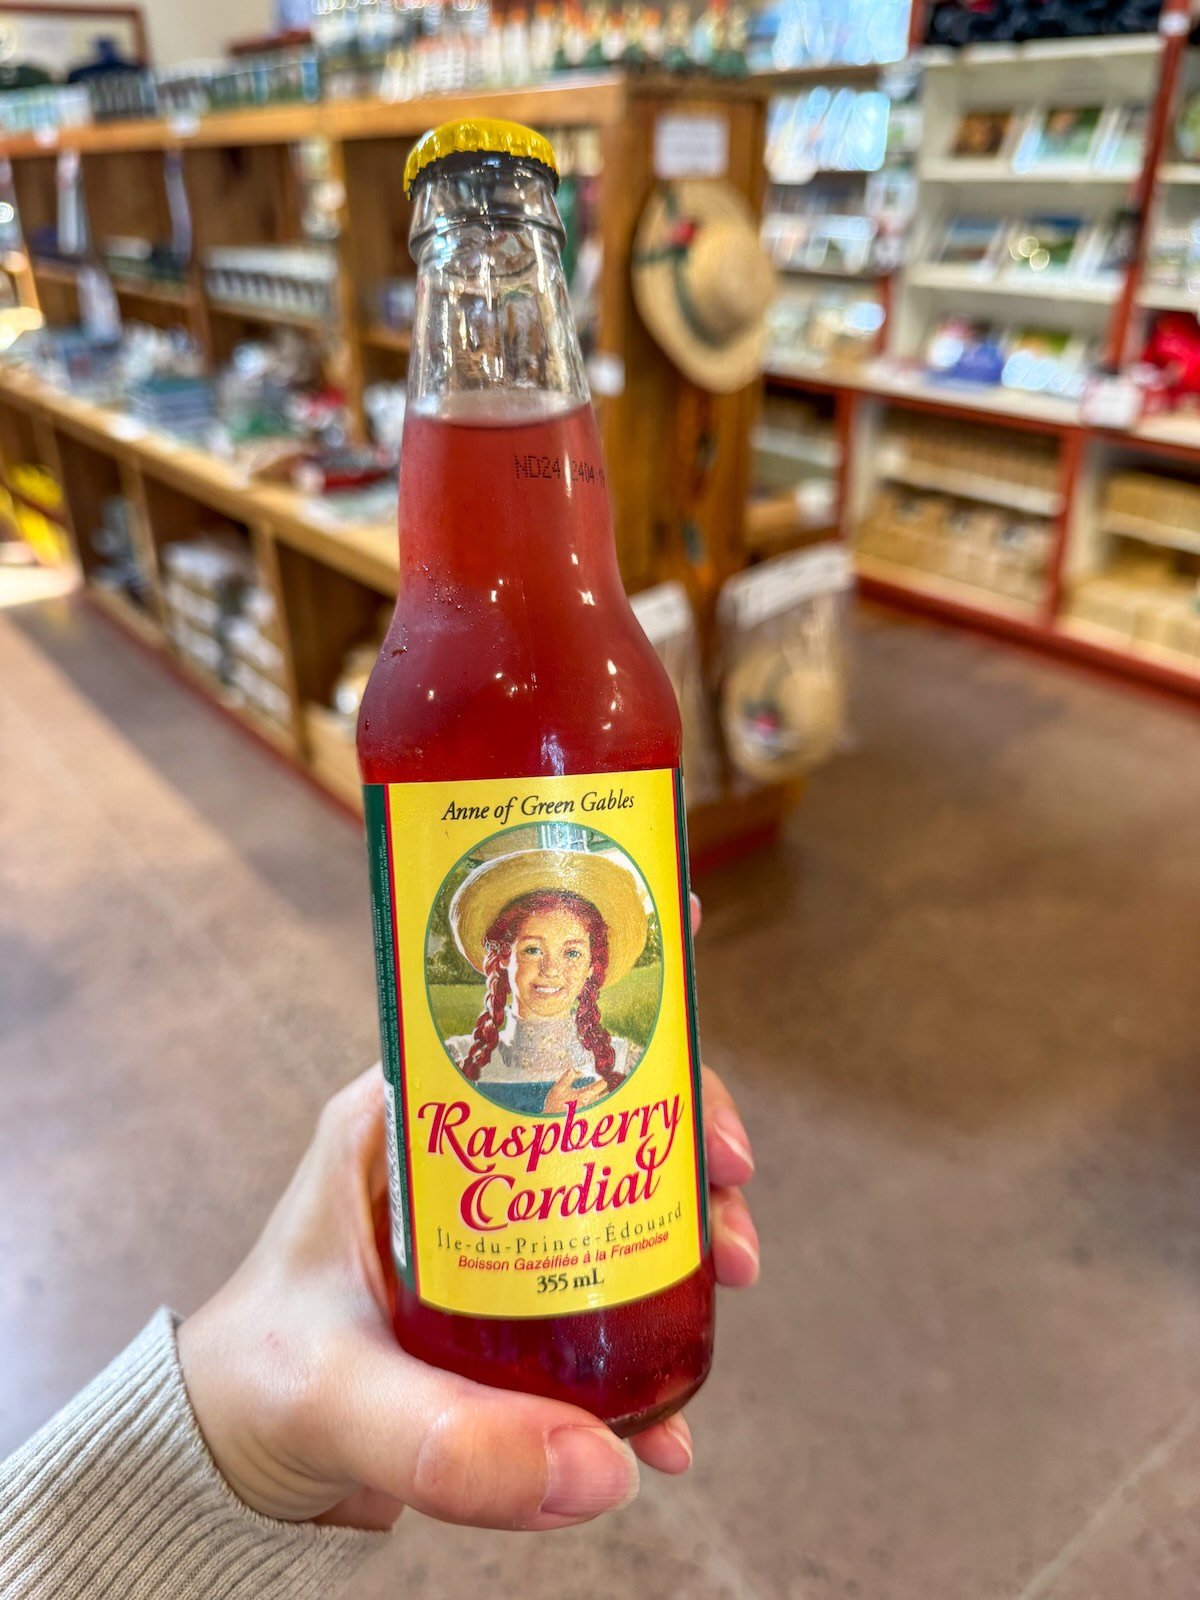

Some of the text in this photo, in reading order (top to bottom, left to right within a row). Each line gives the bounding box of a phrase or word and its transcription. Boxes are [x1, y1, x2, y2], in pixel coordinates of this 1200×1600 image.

[441, 788, 635, 825] Anne of Green Gables
[417, 1093, 685, 1174] Raspberry
[460, 1133, 661, 1232] Cordial
[436, 1202, 682, 1254] Île-du-Prince-Édouard
[458, 1254, 510, 1271] Boisson
[583, 1251, 591, 1264] à
[595, 1249, 606, 1261] la
[610, 1231, 669, 1258] Framboise
[536, 1267, 605, 1294] 355 mL
